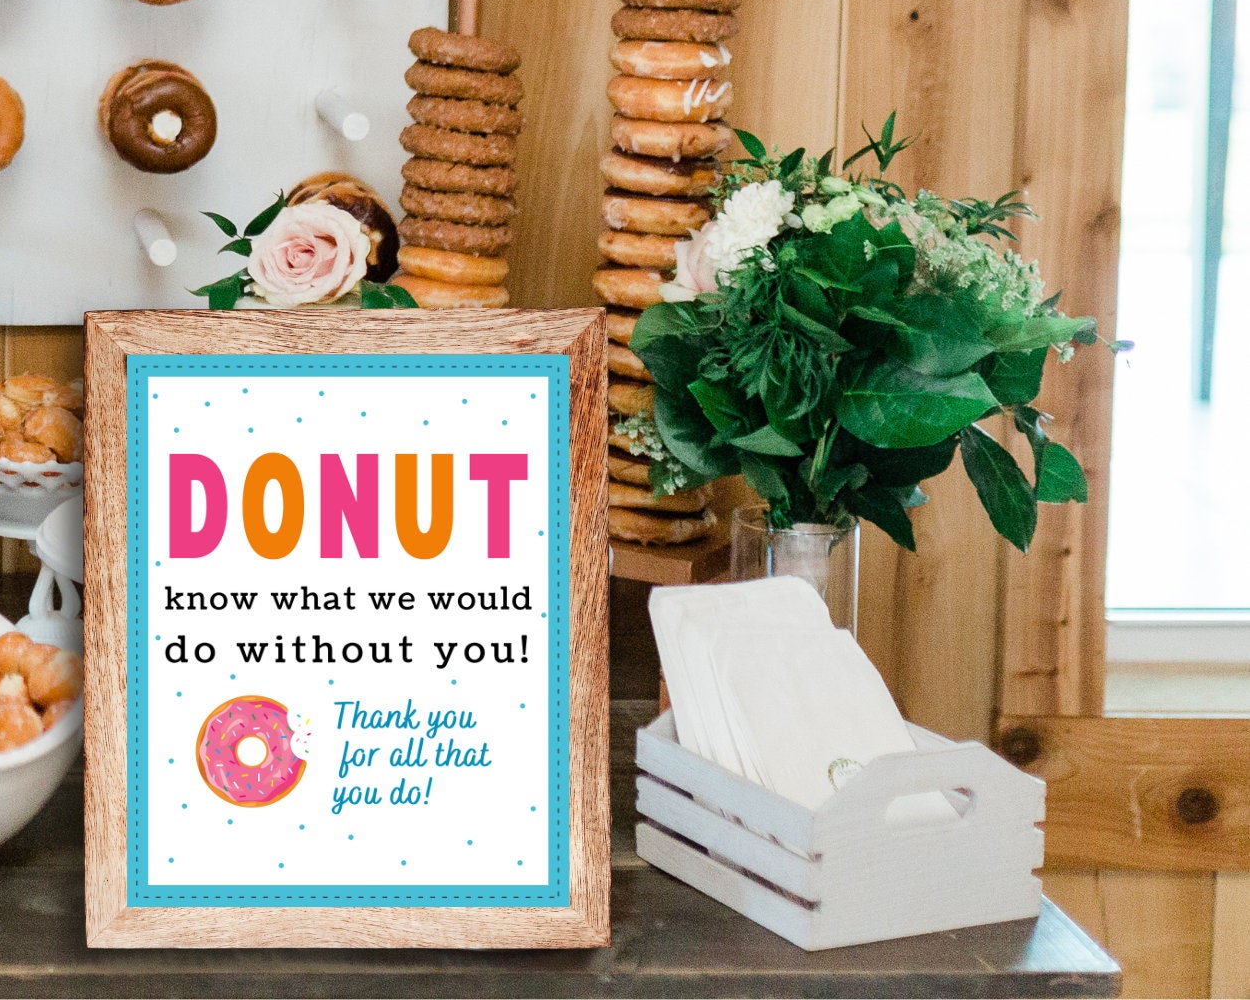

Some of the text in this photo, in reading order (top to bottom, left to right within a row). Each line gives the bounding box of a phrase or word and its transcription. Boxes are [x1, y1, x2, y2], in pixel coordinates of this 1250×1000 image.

[168, 451, 529, 561] DONUT
[164, 585, 533, 611] know what we would
[164, 634, 529, 670] do without you!
[333, 698, 478, 740] Thank you
[338, 737, 493, 779] for all that
[331, 776, 433, 815] you do!
